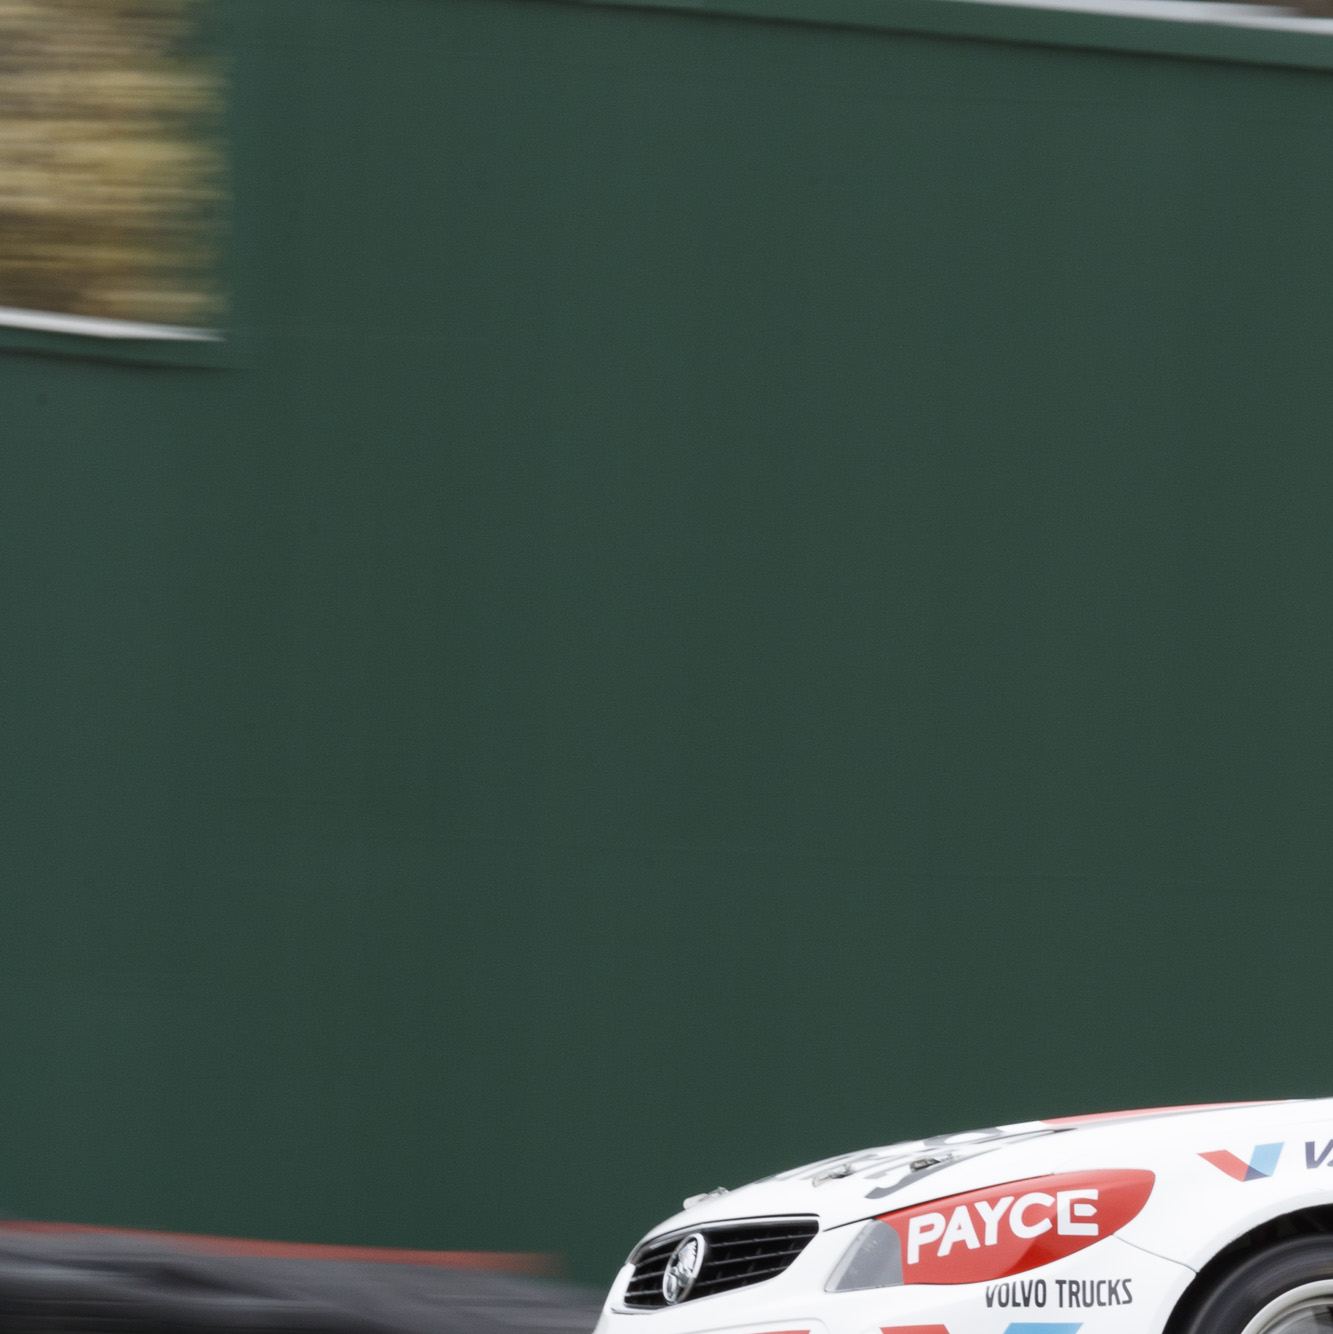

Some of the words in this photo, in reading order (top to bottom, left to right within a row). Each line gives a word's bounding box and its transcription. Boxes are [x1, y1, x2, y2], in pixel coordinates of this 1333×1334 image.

[907, 1189, 1099, 1265] PAYCE
[986, 1279, 1047, 1308] VOLVO
[1055, 1279, 1133, 1308] TRUCKS
